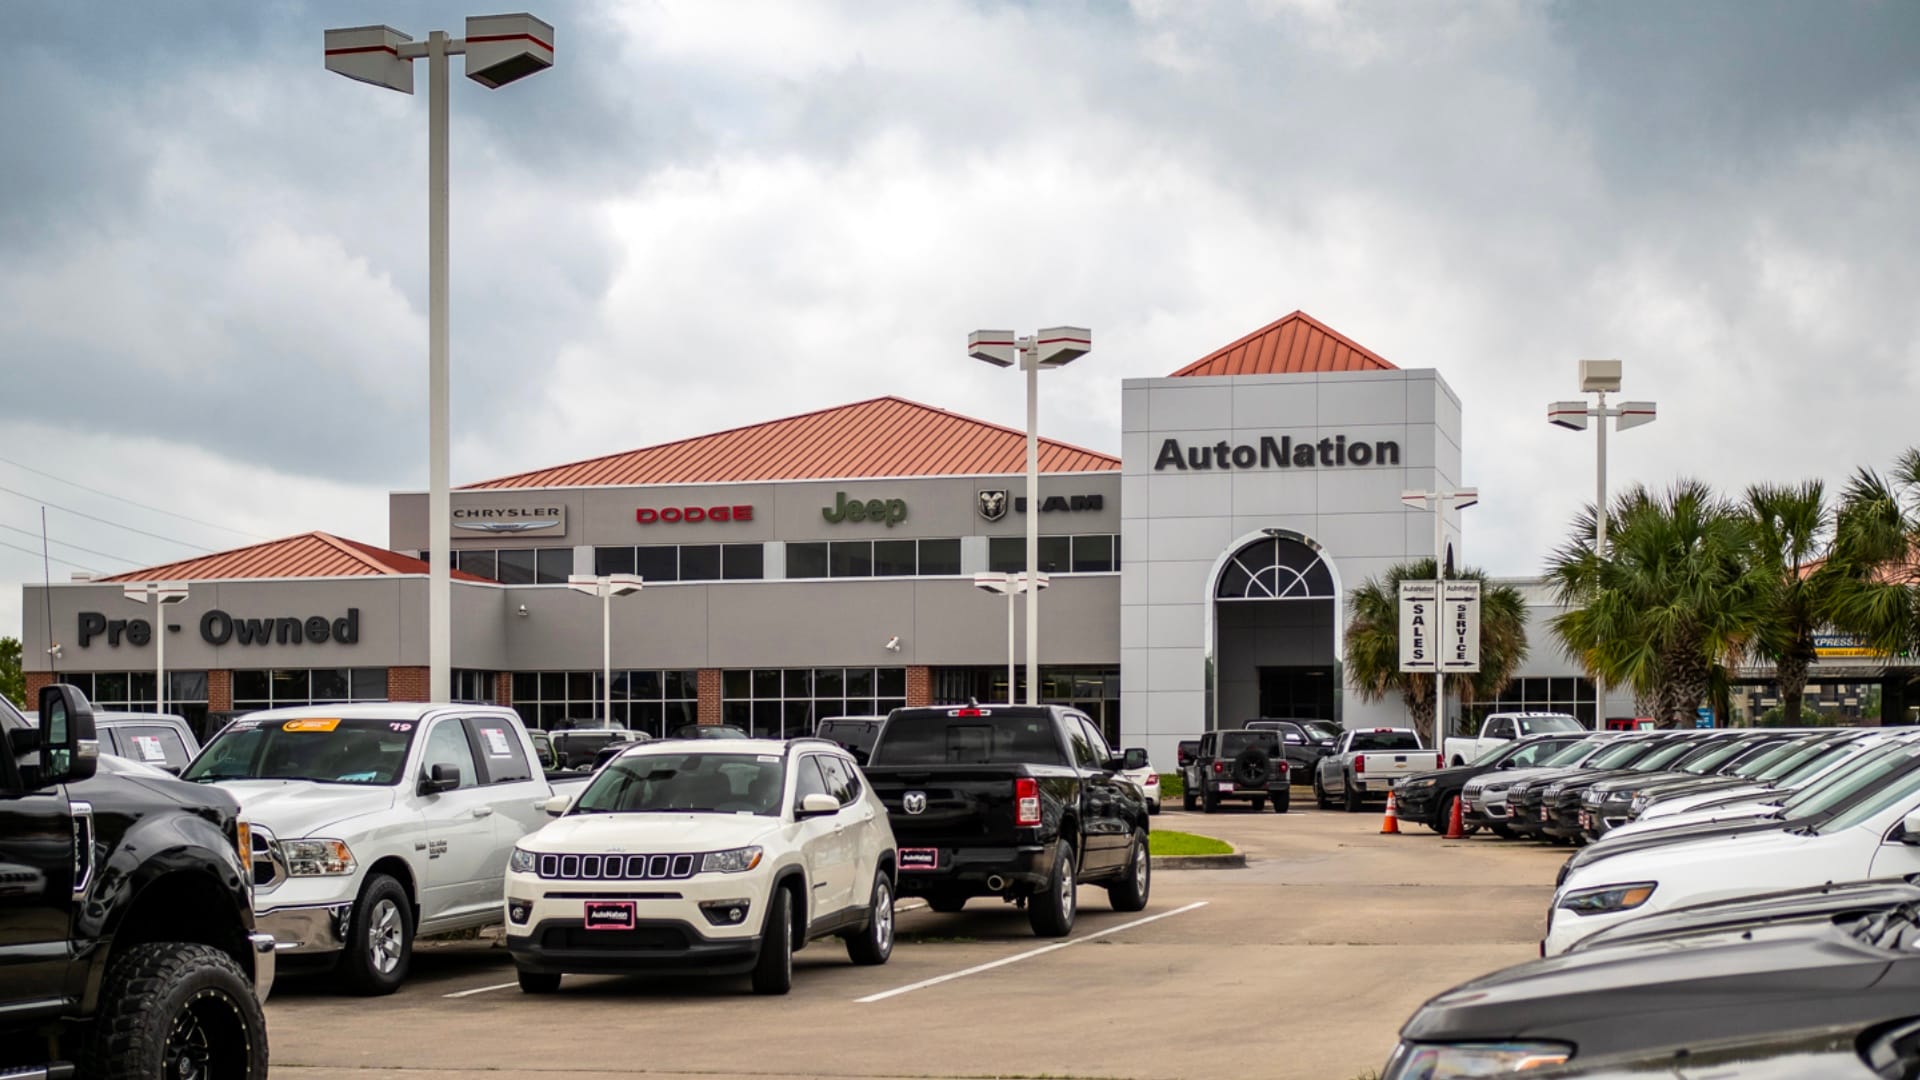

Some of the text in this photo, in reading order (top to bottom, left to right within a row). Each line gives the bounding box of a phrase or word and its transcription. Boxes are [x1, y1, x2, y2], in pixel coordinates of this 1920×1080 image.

[1154, 434, 1400, 471] AutoNation
[453, 507, 560, 518] CHRYSLER
[636, 505, 754, 524] DODGE
[822, 491, 907, 528] Jeep
[78, 612, 151, 648] Pre
[200, 608, 360, 645] Owned
[1412, 604, 1424, 660] SALES
[1456, 604, 1467, 660] SERVICE
